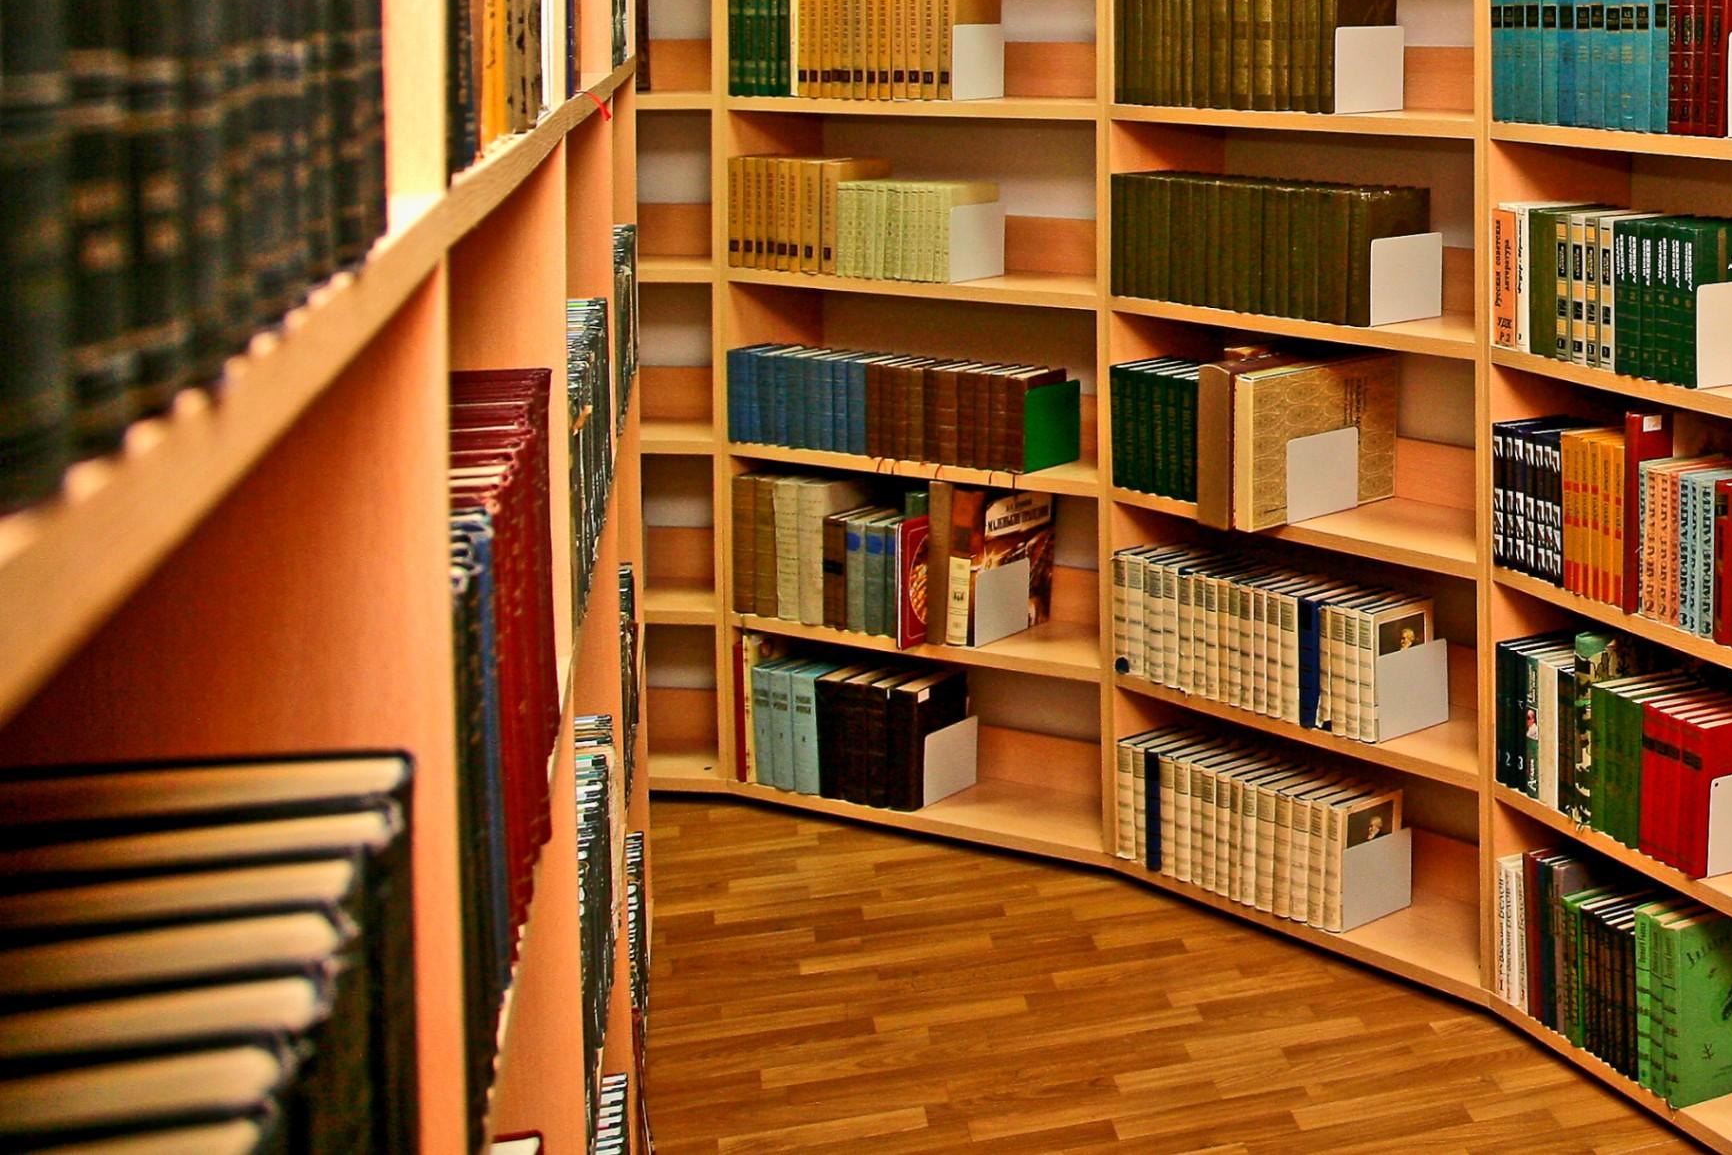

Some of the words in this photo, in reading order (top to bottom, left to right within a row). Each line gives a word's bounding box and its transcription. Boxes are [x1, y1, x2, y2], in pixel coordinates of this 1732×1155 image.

[1494, 219, 1502, 266] советская
[1503, 239, 1512, 292] литература
[1494, 270, 1503, 308] Русская
